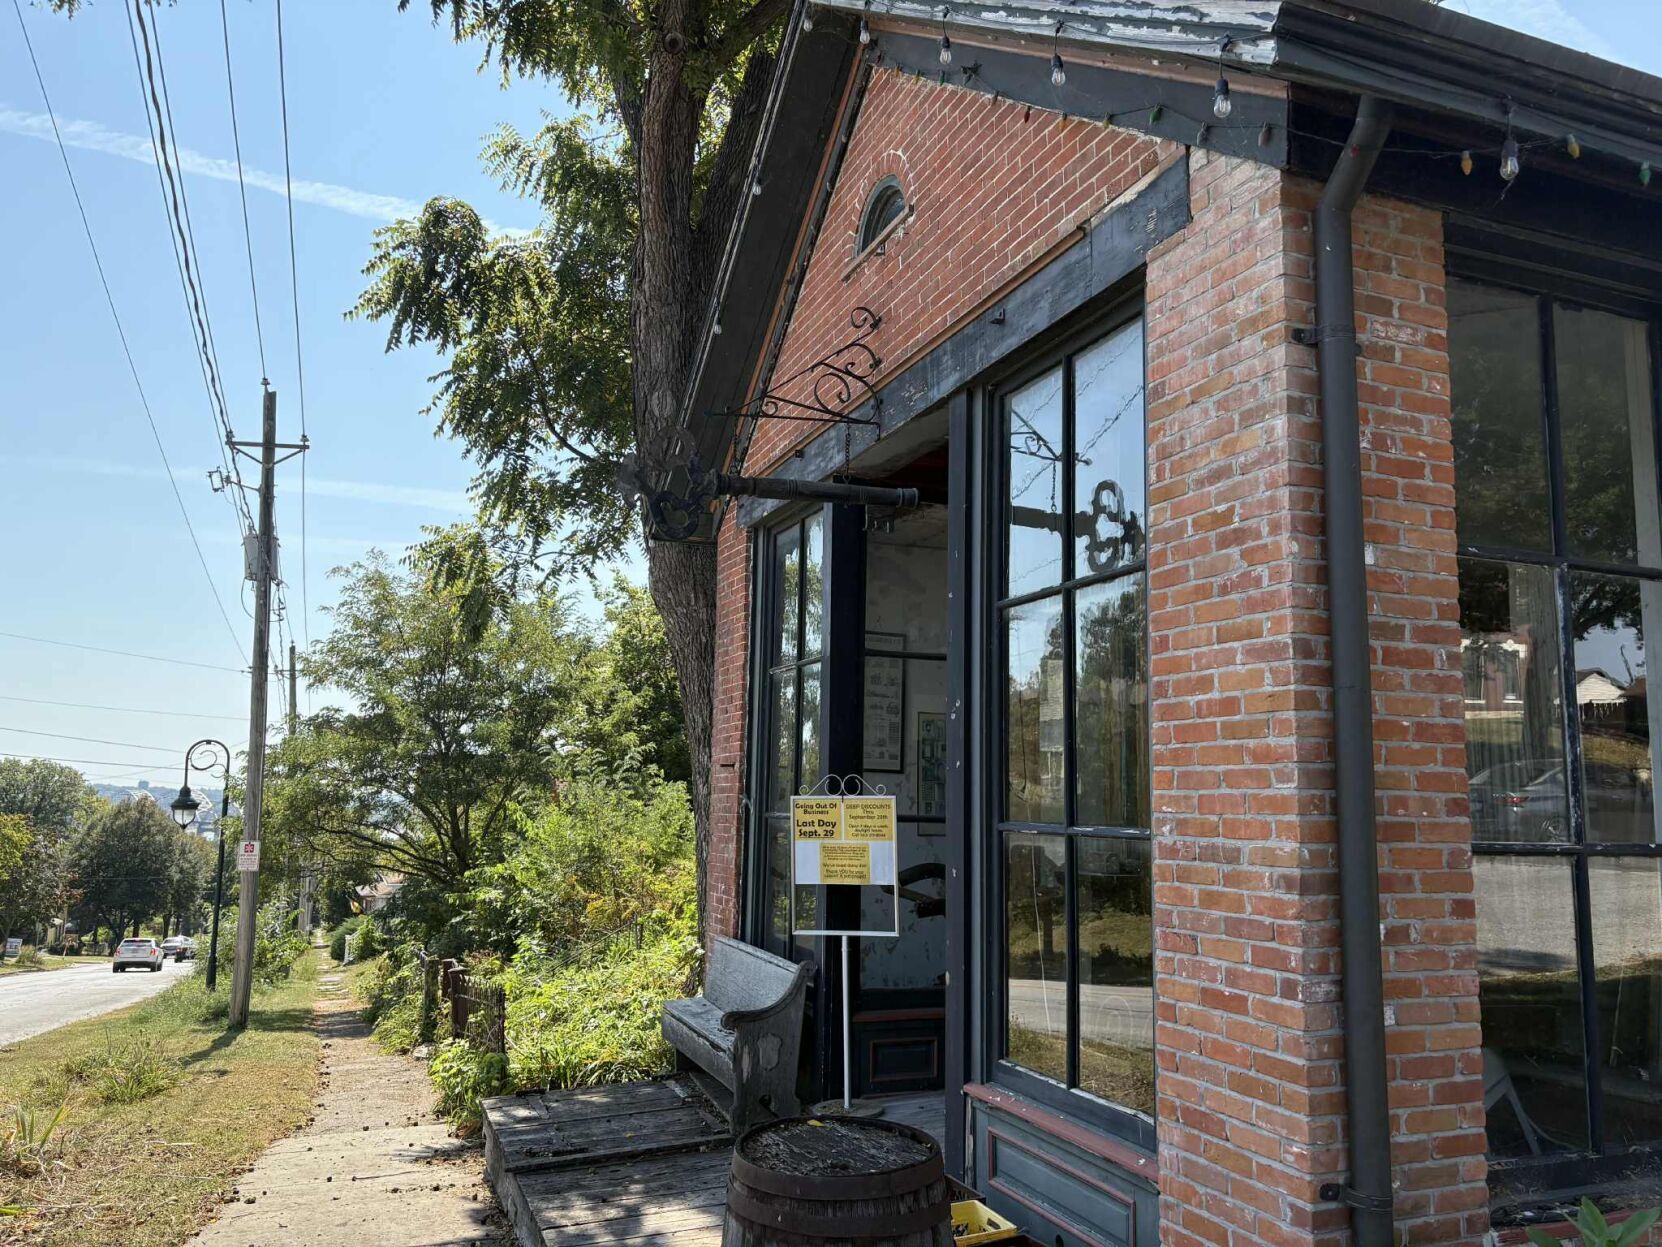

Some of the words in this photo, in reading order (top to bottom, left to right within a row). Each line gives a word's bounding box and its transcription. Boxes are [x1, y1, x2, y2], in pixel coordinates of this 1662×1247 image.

[796, 819, 815, 827] Last
[818, 819, 836, 828] Day
[799, 829, 821, 837] Sept.
